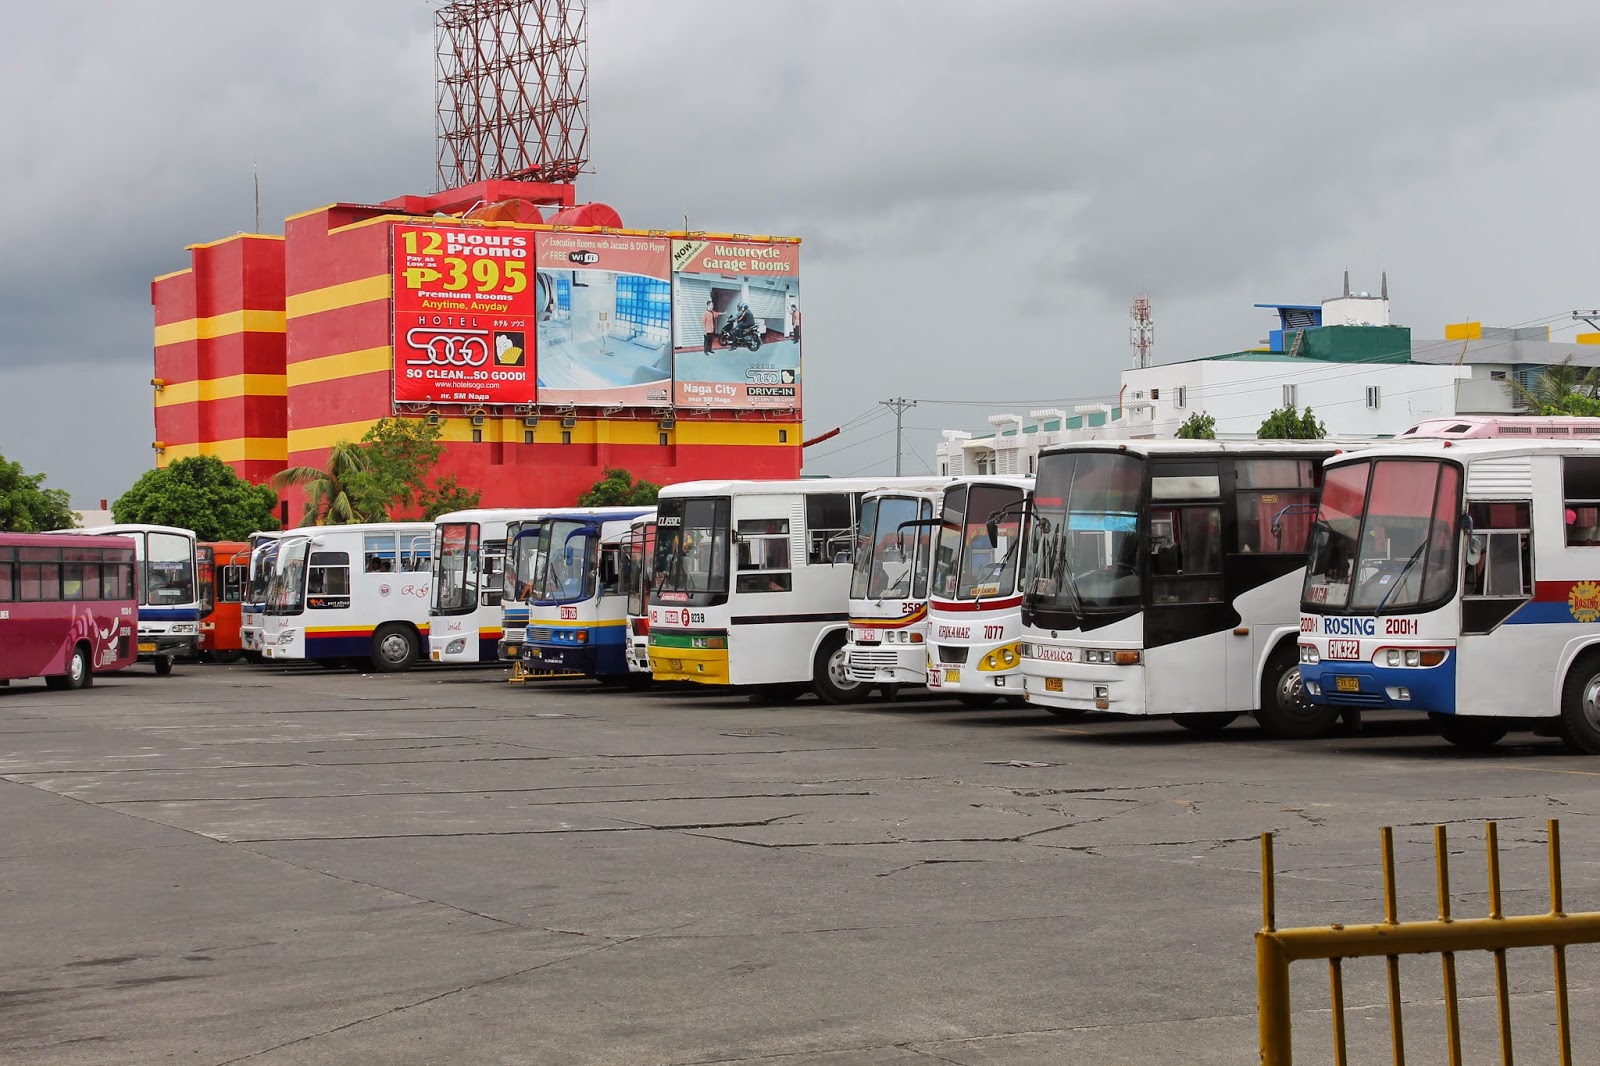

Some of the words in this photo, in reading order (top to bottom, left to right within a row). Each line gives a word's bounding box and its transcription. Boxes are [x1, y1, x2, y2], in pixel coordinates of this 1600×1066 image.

[401, 231, 443, 255] 12
[446, 232, 527, 246] Hours
[549, 237, 576, 248] Executive
[577, 239, 596, 249] Rooms
[596, 240, 609, 250] with
[610, 240, 629, 250] Jacuzzi
[636, 242, 648, 251] DVD
[649, 242, 666, 254] Player
[447, 243, 527, 258] Promo
[549, 251, 567, 261] FREE
[674, 242, 693, 261] NOW
[714, 245, 780, 259] Motorcycle
[702, 257, 747, 272] Garage
[751, 259, 790, 271] Rooms
[418, 290, 471, 299] Premium
[475, 293, 513, 301] Rooms
[422, 300, 468, 311] Anytime,
[471, 301, 508, 312] Anyday
[418, 315, 478, 327] HOTEL
[406, 327, 489, 367] SOGO
[406, 369, 423, 378] SO
[491, 371, 527, 381] GOOD!
[434, 381, 500, 390] www.hotelsogo.com
[683, 383, 712, 394] Naga
[715, 384, 737, 397] City
[748, 387, 794, 396] DRIVE-IN
[468, 393, 490, 401] Naga
[658, 516, 682, 527] CLASSIC
[1574, 595, 1599, 611] ROSING
[984, 625, 1004, 640] 7077
[1324, 618, 1375, 636] ROSING
[1386, 619, 1418, 635] 2001-1
[1037, 645, 1073, 661] Danica
